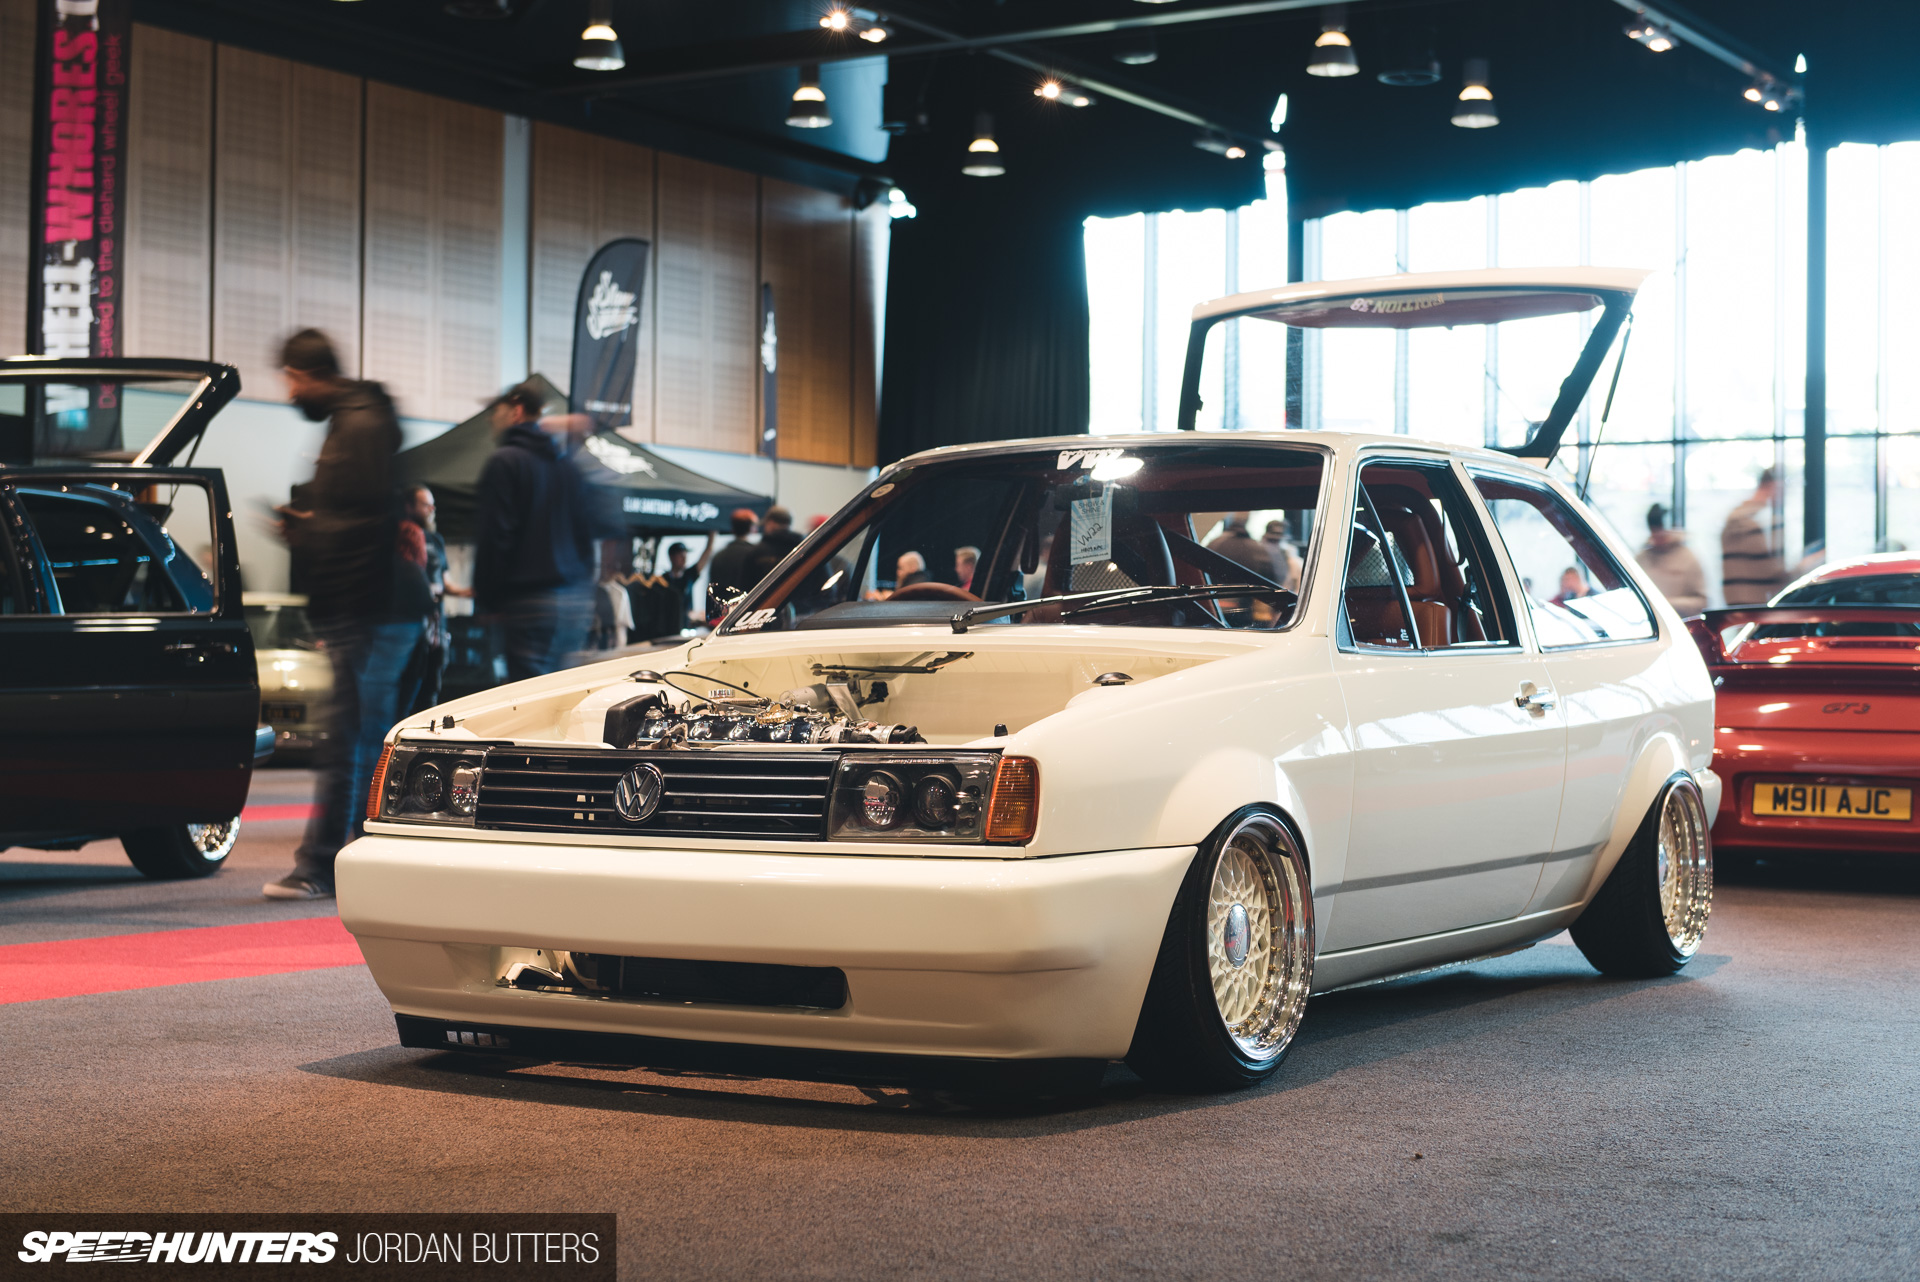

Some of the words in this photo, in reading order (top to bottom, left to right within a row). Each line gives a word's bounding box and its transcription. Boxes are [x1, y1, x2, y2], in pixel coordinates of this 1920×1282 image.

[104, 33, 125, 86] geek
[101, 90, 120, 150] wheel
[98, 156, 117, 234] diehard
[98, 238, 114, 272] the
[98, 274, 114, 298] to
[1078, 523, 1103, 546] VW22
[1821, 702, 1872, 715] GT3
[1772, 786, 1826, 812] M911
[1837, 788, 1891, 815] AJC
